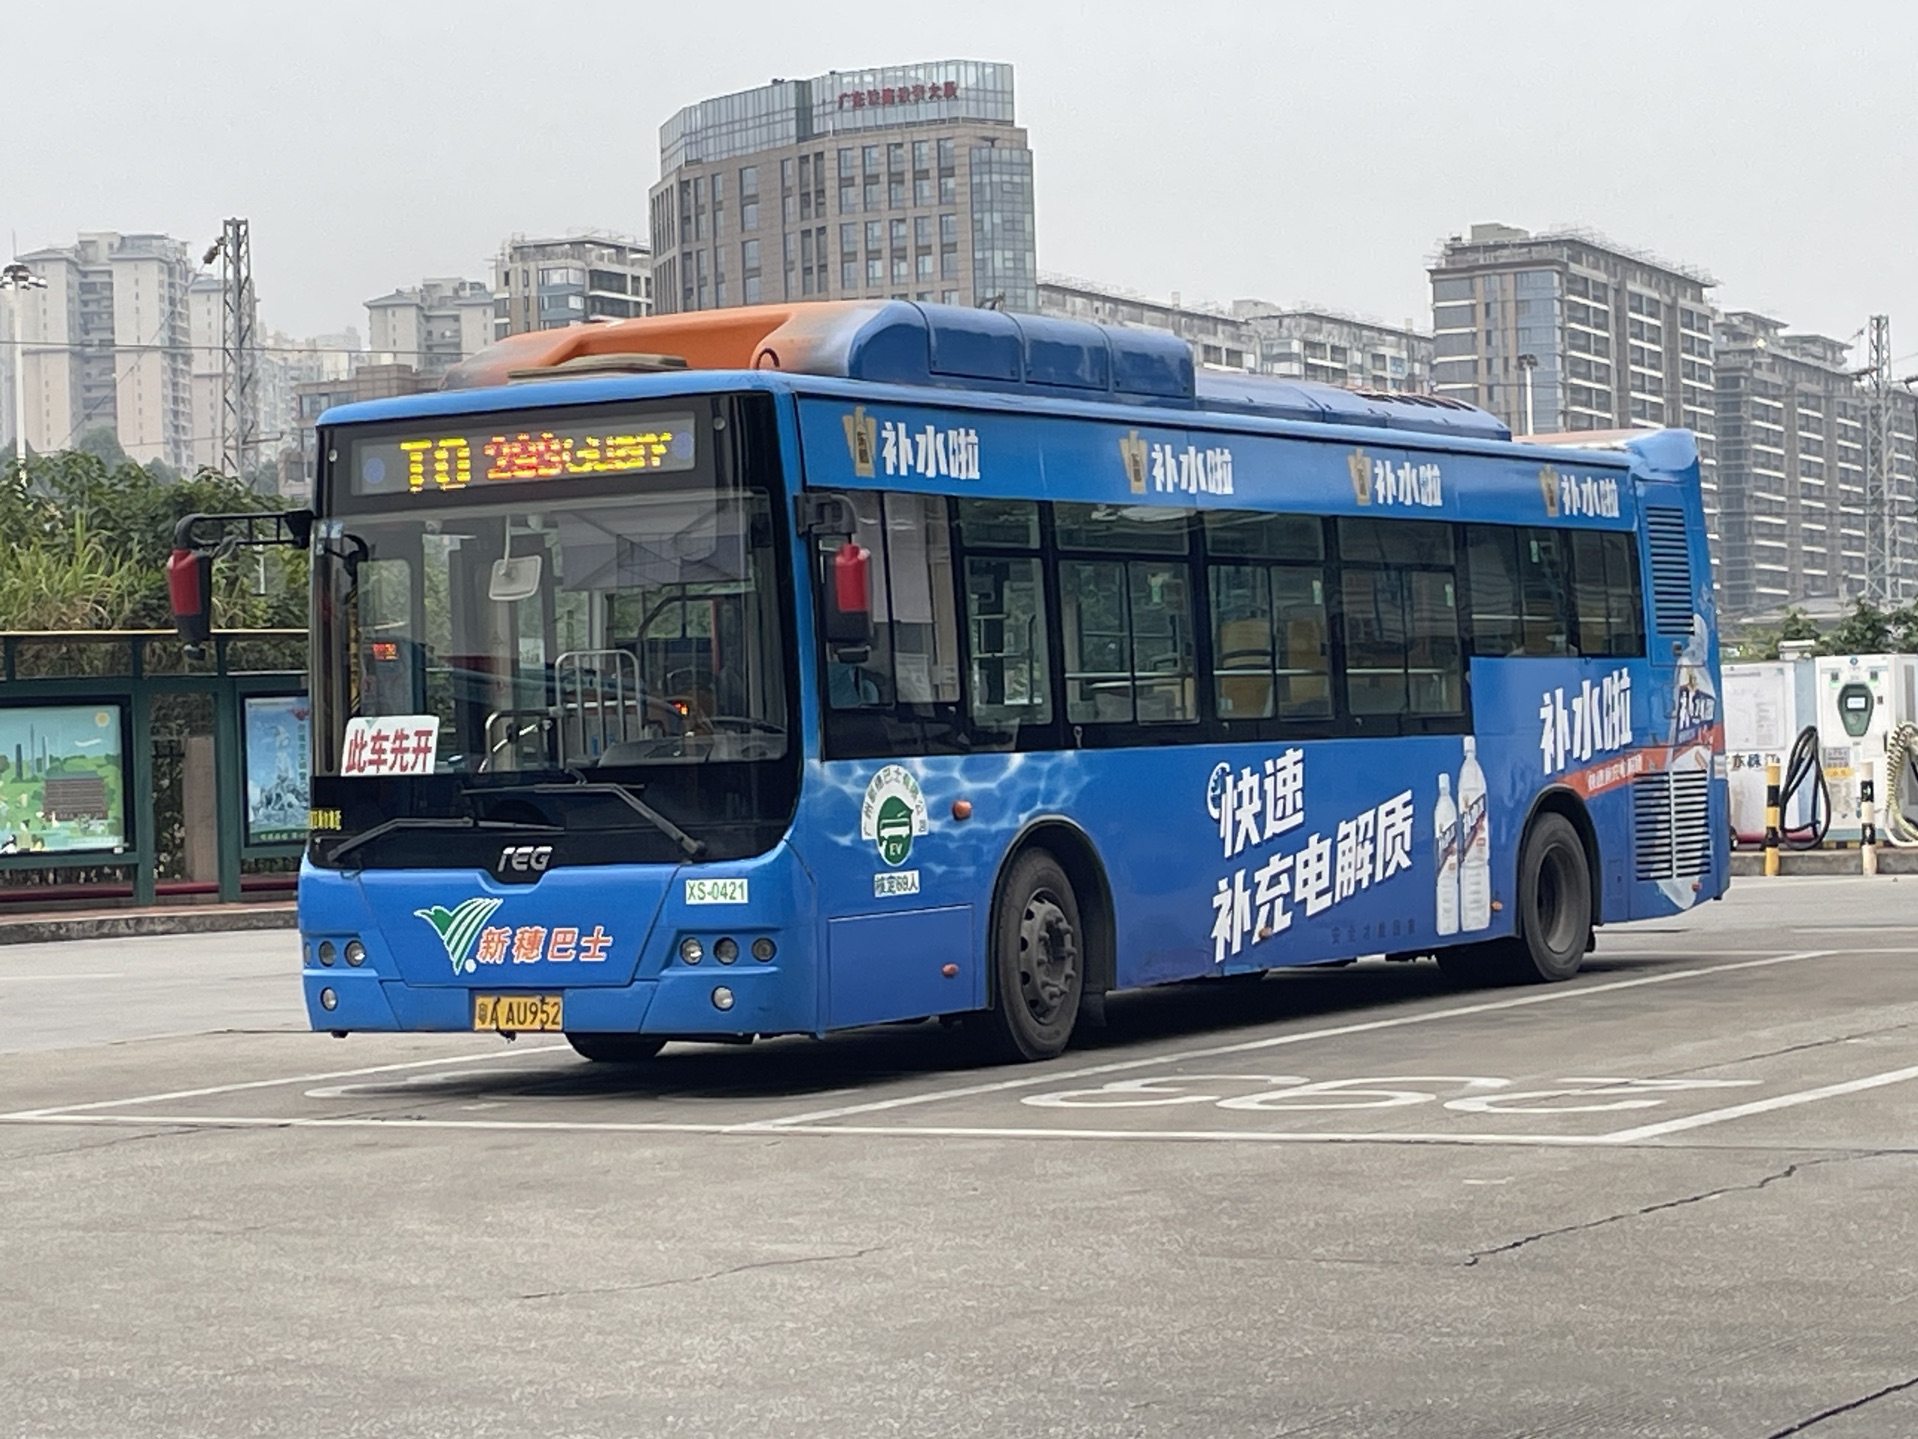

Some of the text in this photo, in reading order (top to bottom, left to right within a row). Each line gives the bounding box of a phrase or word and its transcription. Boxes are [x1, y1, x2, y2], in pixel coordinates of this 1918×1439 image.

[881, 421, 980, 480] 补水啦
[1151, 443, 1234, 495] 补水啦
[1374, 460, 1443, 507] 补水啦
[1559, 475, 1620, 518] 补水啦
[1540, 667, 1633, 775] 补水啦
[345, 727, 434, 774] 此车先开
[1219, 748, 1305, 858] 快速
[889, 843, 903, 857] EV
[687, 881, 746, 901] XS-0421
[1211, 790, 1415, 963] 补充电解质
[475, 926, 612, 964] 新穗巴士
